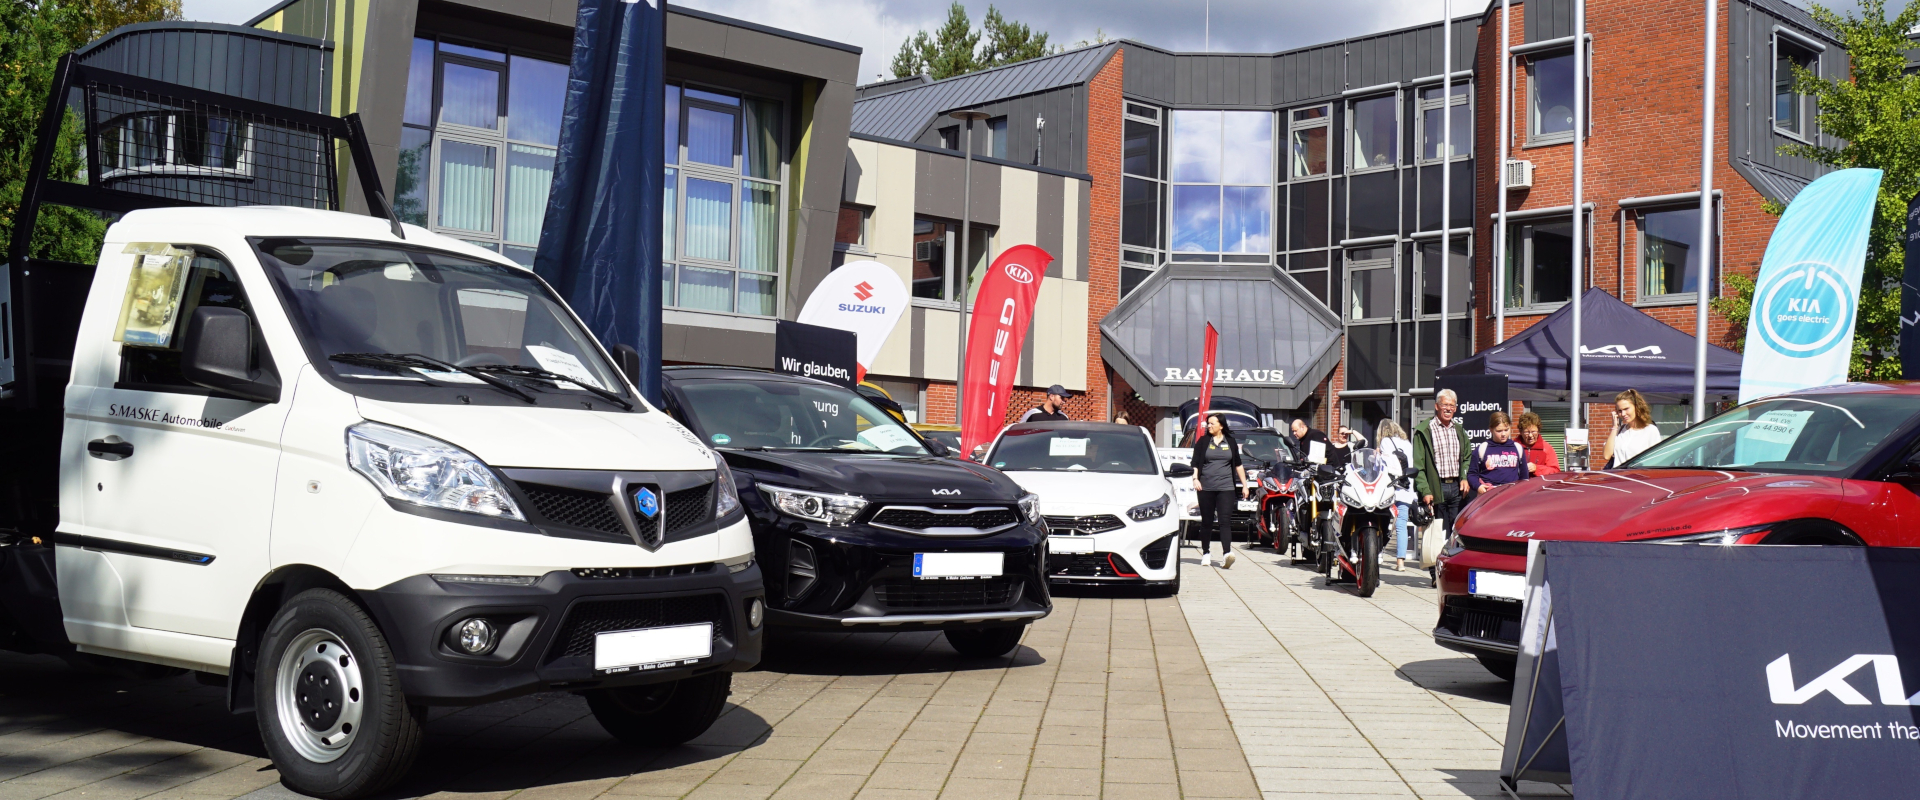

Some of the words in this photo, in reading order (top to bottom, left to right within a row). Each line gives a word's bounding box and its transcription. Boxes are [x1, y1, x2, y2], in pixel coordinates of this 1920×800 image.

[1009, 265, 1028, 282] KIA
[838, 303, 885, 314] SUZUKI
[1787, 297, 1821, 314] KIA
[1777, 314, 1797, 322] goes
[1798, 314, 1830, 324] electric
[781, 356, 801, 372] Wir
[803, 361, 851, 381] glauben,
[1165, 367, 1284, 381] RAHAUS
[1460, 401, 1502, 414] glauben,
[108, 403, 161, 421] S.MASKE
[161, 412, 223, 430] Automobile
[1762, 424, 1788, 433] 44.990
[1765, 653, 1920, 706] KI
[1775, 719, 1882, 739] Movement
[1887, 721, 1920, 740] tha
